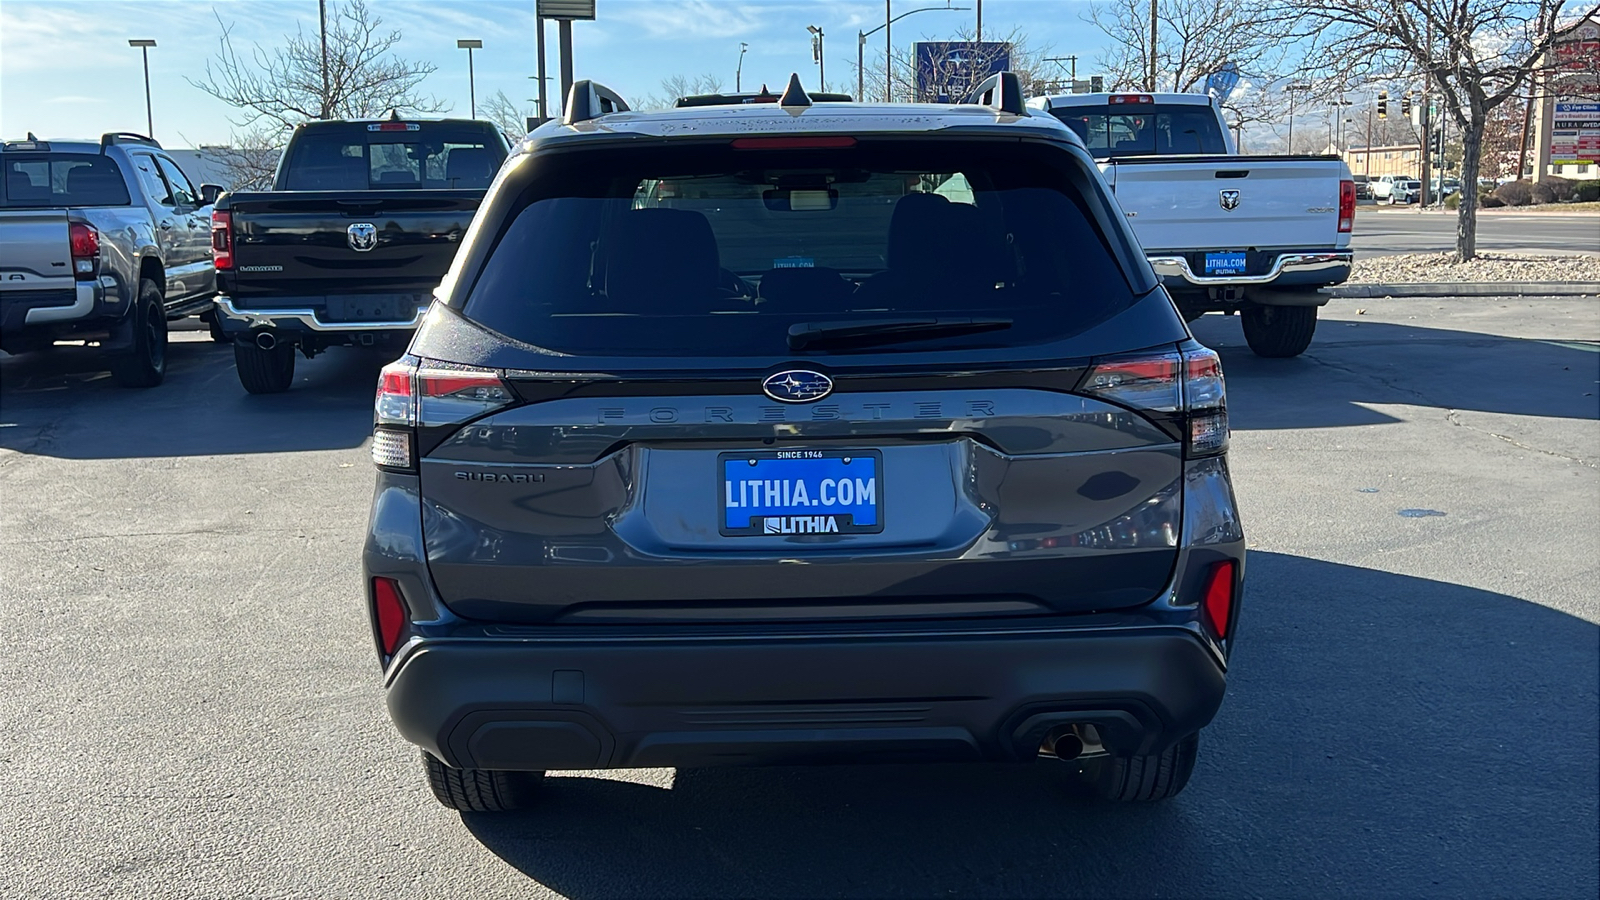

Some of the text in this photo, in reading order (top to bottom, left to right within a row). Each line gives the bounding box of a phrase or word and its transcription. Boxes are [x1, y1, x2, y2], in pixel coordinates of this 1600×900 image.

[1205, 258, 1246, 268] LITHIA.COM
[598, 400, 995, 424] FORESTER
[777, 451, 823, 459] SINCE 1946
[454, 471, 546, 484] SUBARU
[725, 478, 876, 509] LITHIA.COM
[781, 516, 839, 534] LITHIA
